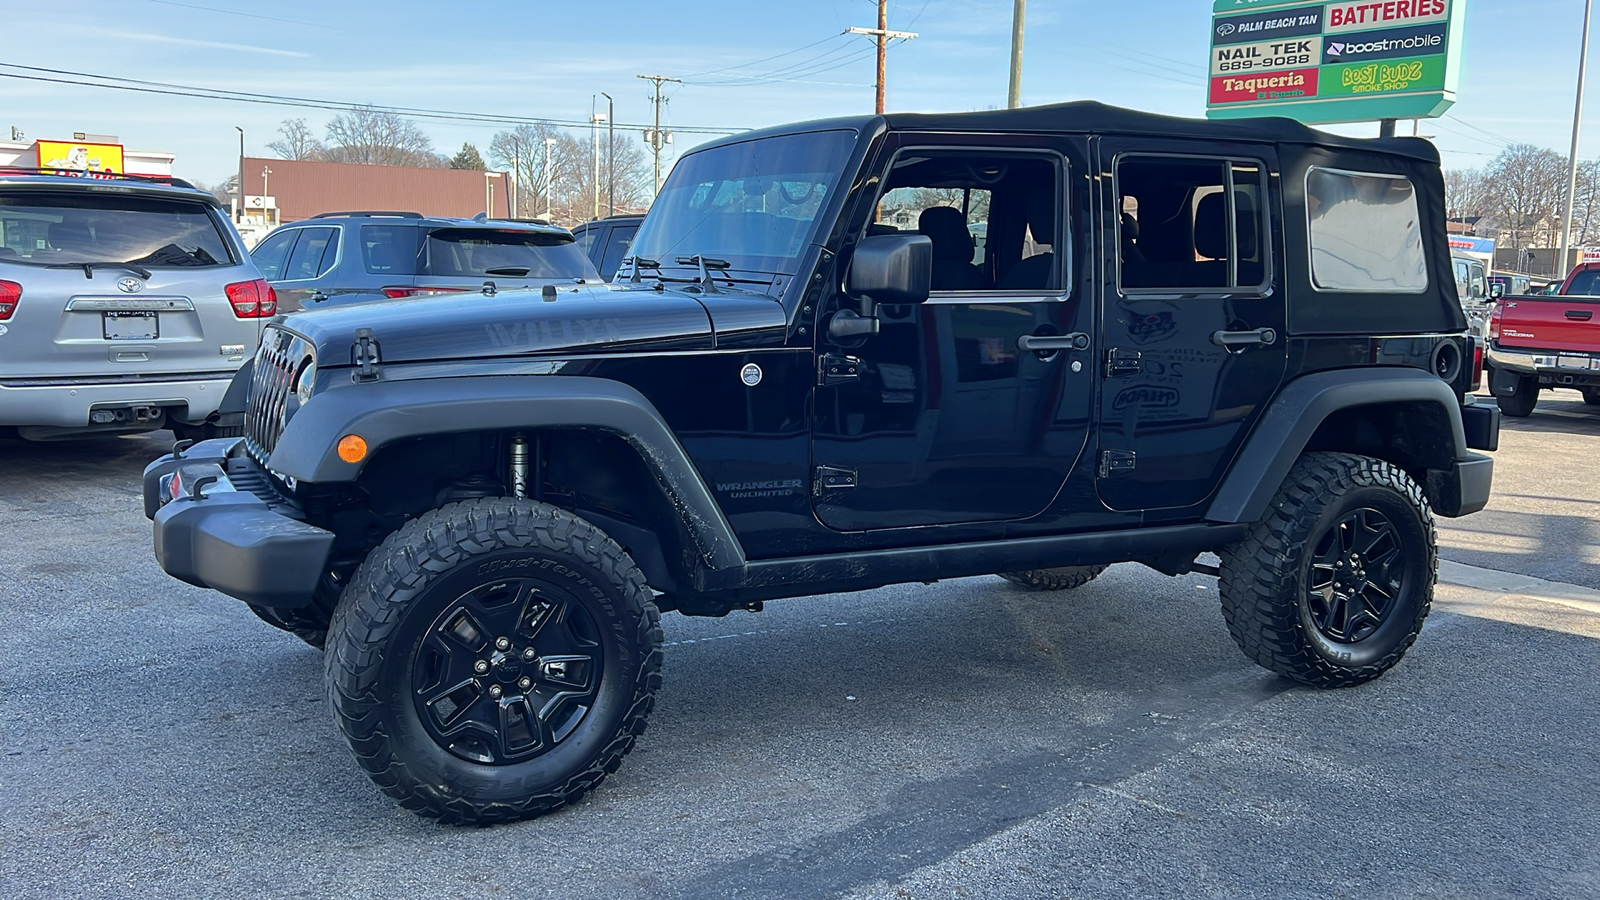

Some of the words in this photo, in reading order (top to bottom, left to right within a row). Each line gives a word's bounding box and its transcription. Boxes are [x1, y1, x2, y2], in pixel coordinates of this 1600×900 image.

[1330, 0, 1445, 27] BATTERIES
[1238, 21, 1263, 33] PALM
[1265, 17, 1296, 30] BEACH
[1298, 14, 1318, 26] TAN
[1218, 46, 1262, 61] NAIL
[1270, 40, 1312, 55] TEK
[1220, 54, 1310, 71] 689-9088
[1352, 83, 1382, 93] SMOKE
[1383, 81, 1409, 91] SHOP
[716, 478, 803, 492] WRANGLER
[730, 489, 793, 499] UNLIMITED
